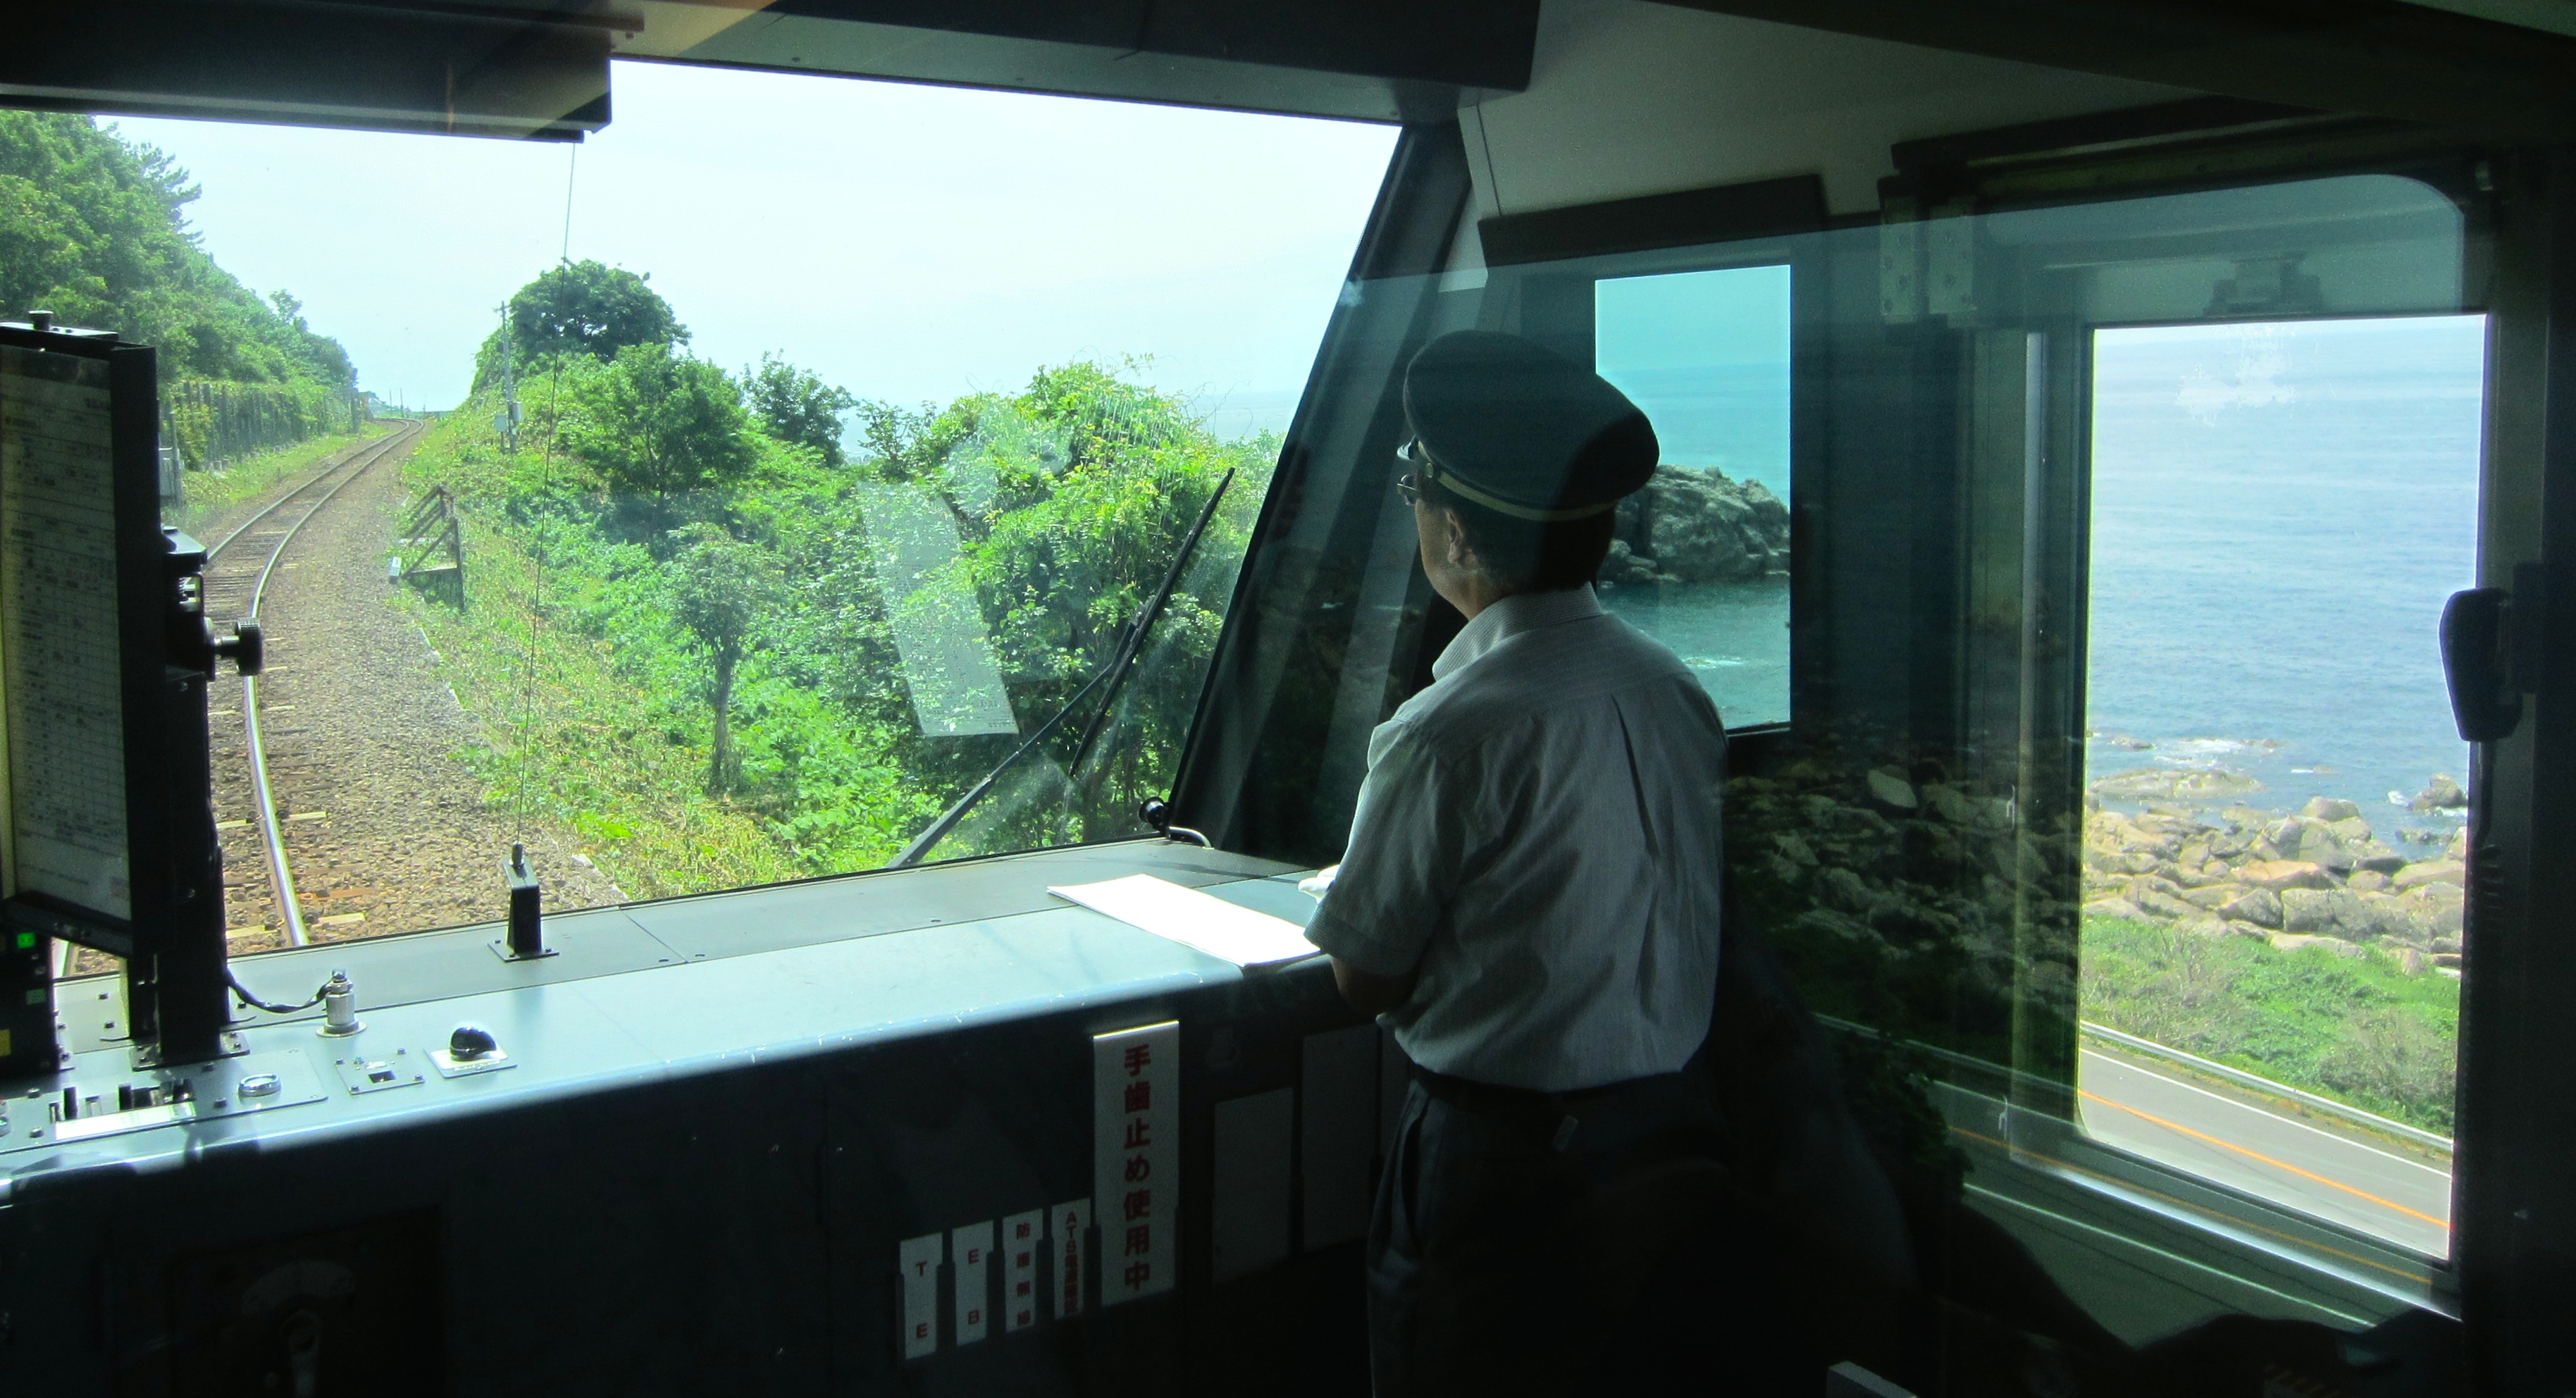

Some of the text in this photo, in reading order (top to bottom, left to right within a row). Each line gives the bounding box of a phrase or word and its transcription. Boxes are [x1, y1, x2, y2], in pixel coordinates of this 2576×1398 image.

[1124, 1044, 1151, 1291] 手歯止め使用中
